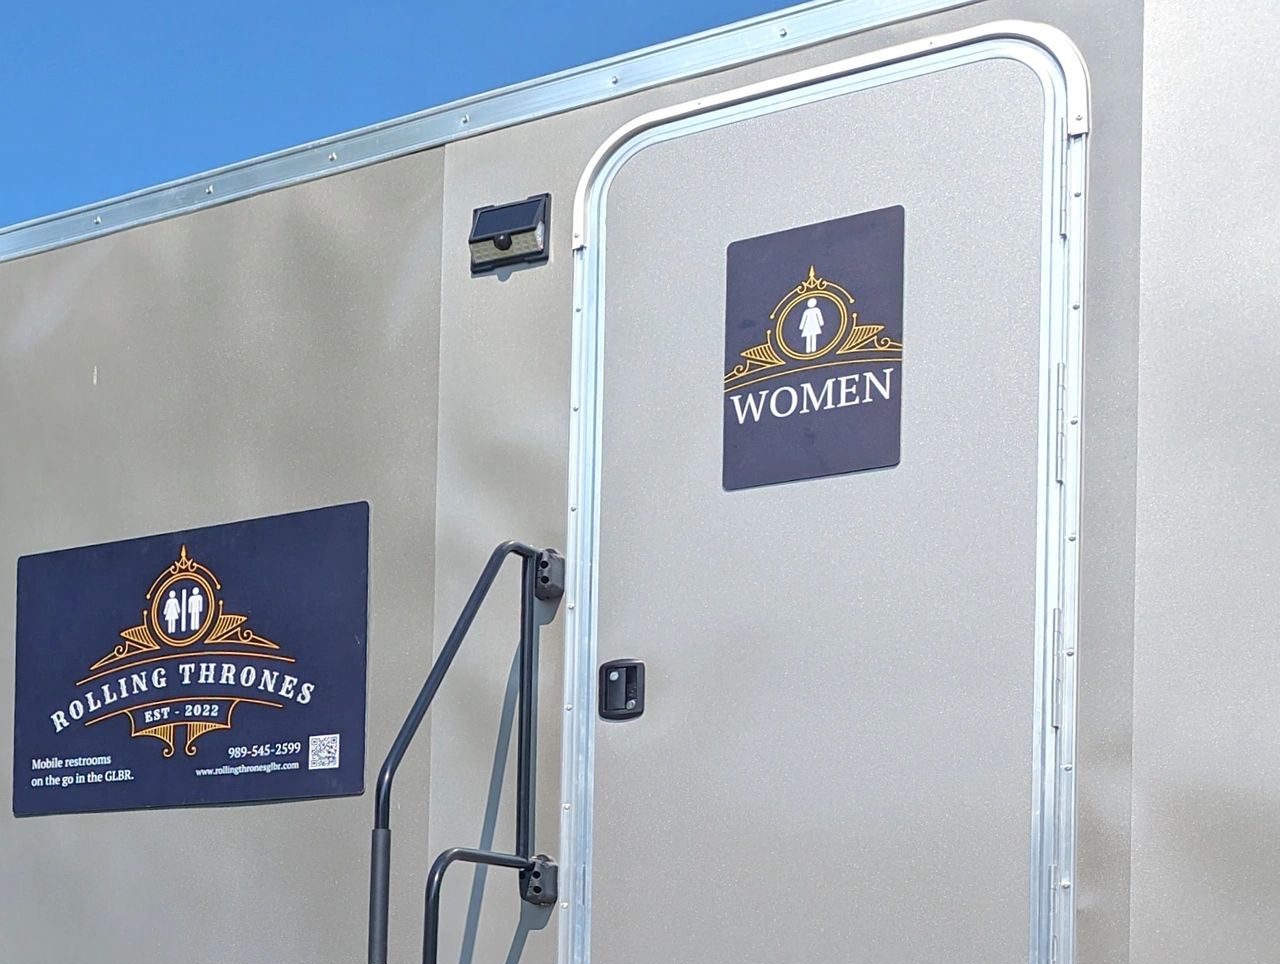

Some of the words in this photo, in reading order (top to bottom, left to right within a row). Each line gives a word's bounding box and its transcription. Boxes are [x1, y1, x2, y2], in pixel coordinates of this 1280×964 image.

[730, 368, 894, 425] WOMEN
[50, 668, 167, 733] ROLLING
[179, 663, 315, 704] THRONES
[144, 707, 170, 723] EST
[184, 704, 219, 717] 2022
[228, 742, 301, 759] 989-545-2599
[31, 757, 63, 770] Mobile
[64, 755, 112, 768] restrooms
[195, 762, 299, 776] www.rollingthronesglbr.com
[31, 778, 43, 787] on
[45, 774, 60, 786] the
[61, 776, 74, 787] go
[75, 773, 86, 784] in
[87, 771, 103, 783] the
[104, 769, 134, 782] GLBR.
